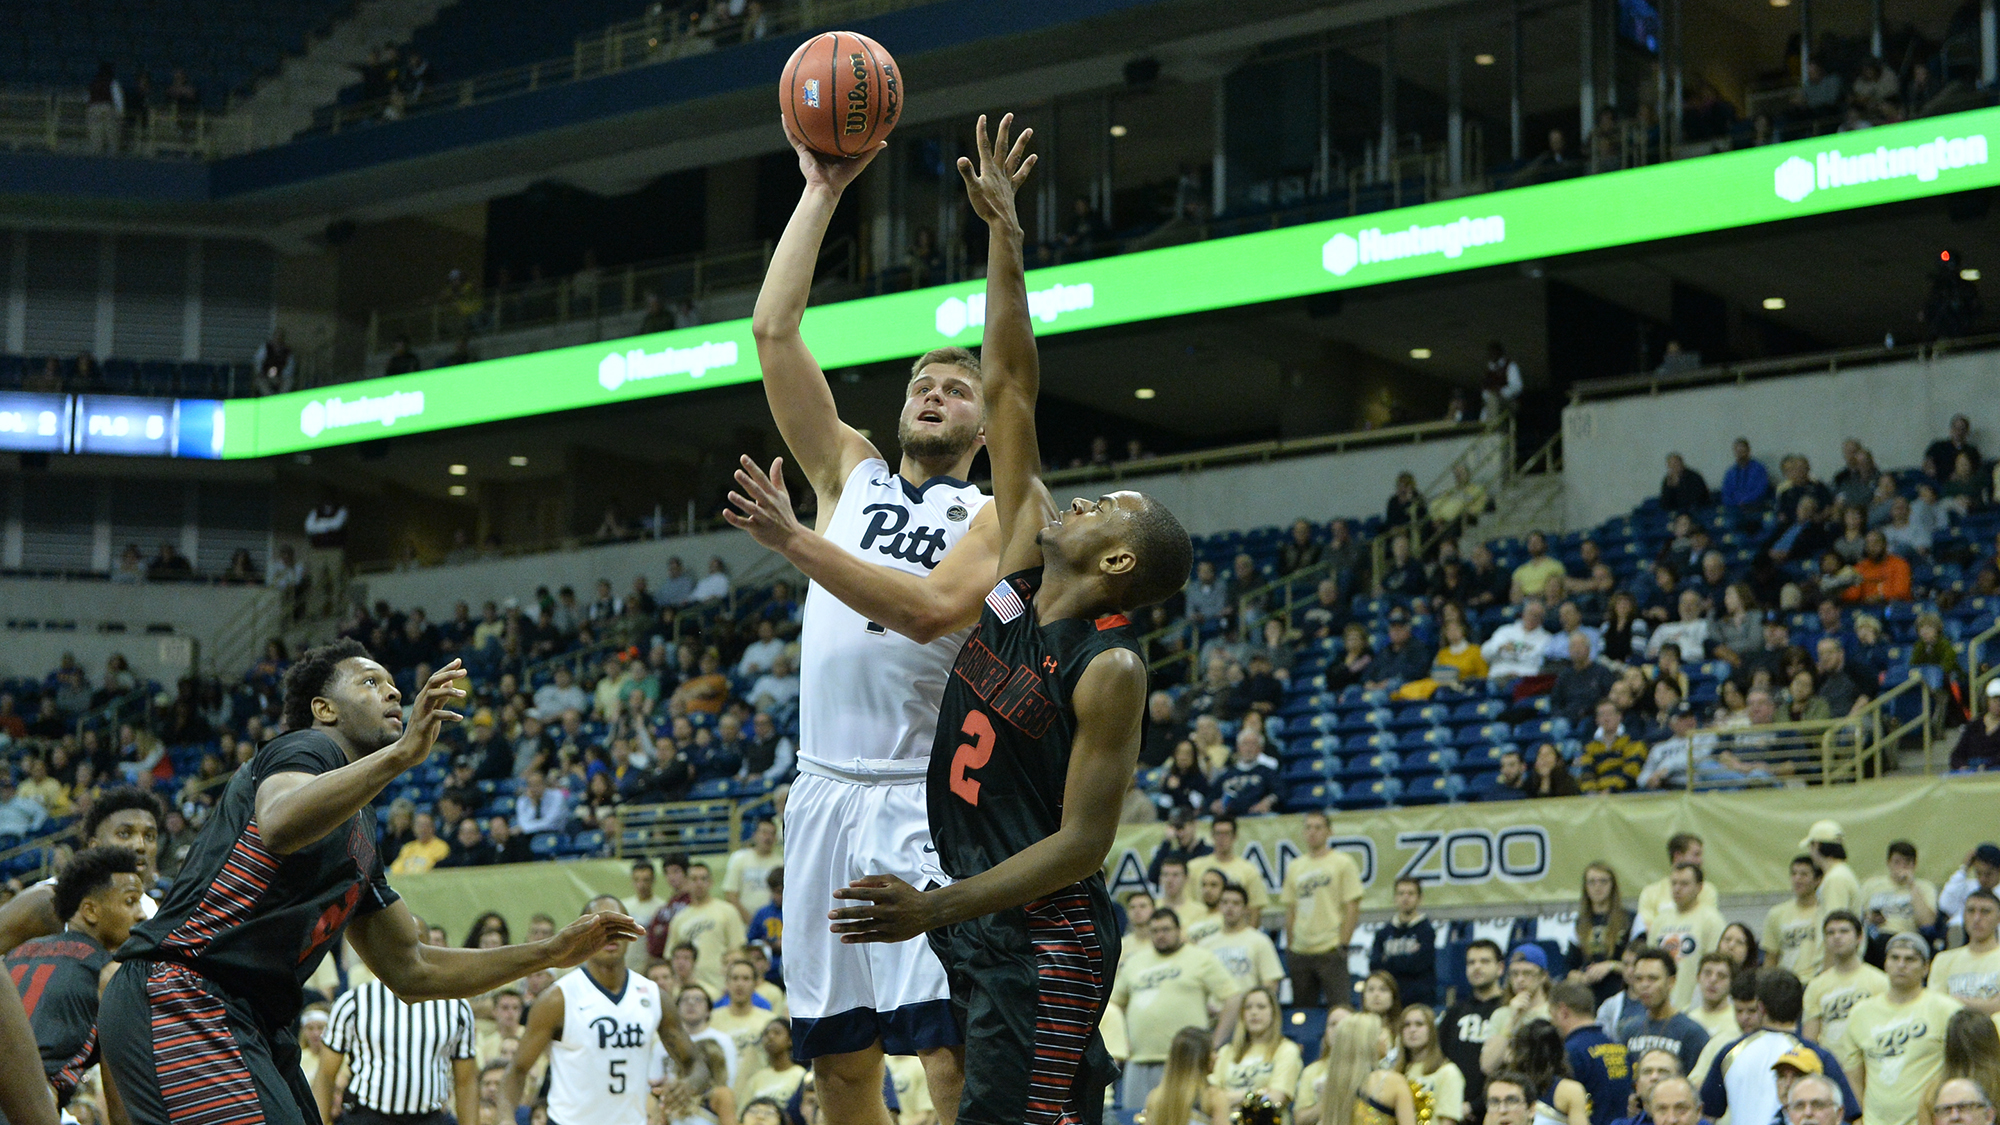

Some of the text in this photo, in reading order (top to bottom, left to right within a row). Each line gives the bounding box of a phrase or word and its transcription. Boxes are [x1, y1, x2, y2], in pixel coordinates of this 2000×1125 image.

[844, 51, 869, 136] Wilson
[883, 63, 898, 125] NCAA
[1816, 134, 1988, 190] Huntington
[1359, 215, 1505, 264] Huntington
[860, 503, 946, 569] Pitt
[949, 709, 996, 806] 2
[1398, 826, 1550, 884] ZOO
[590, 1016, 644, 1050] Pitt
[609, 1059, 626, 1095] 5
